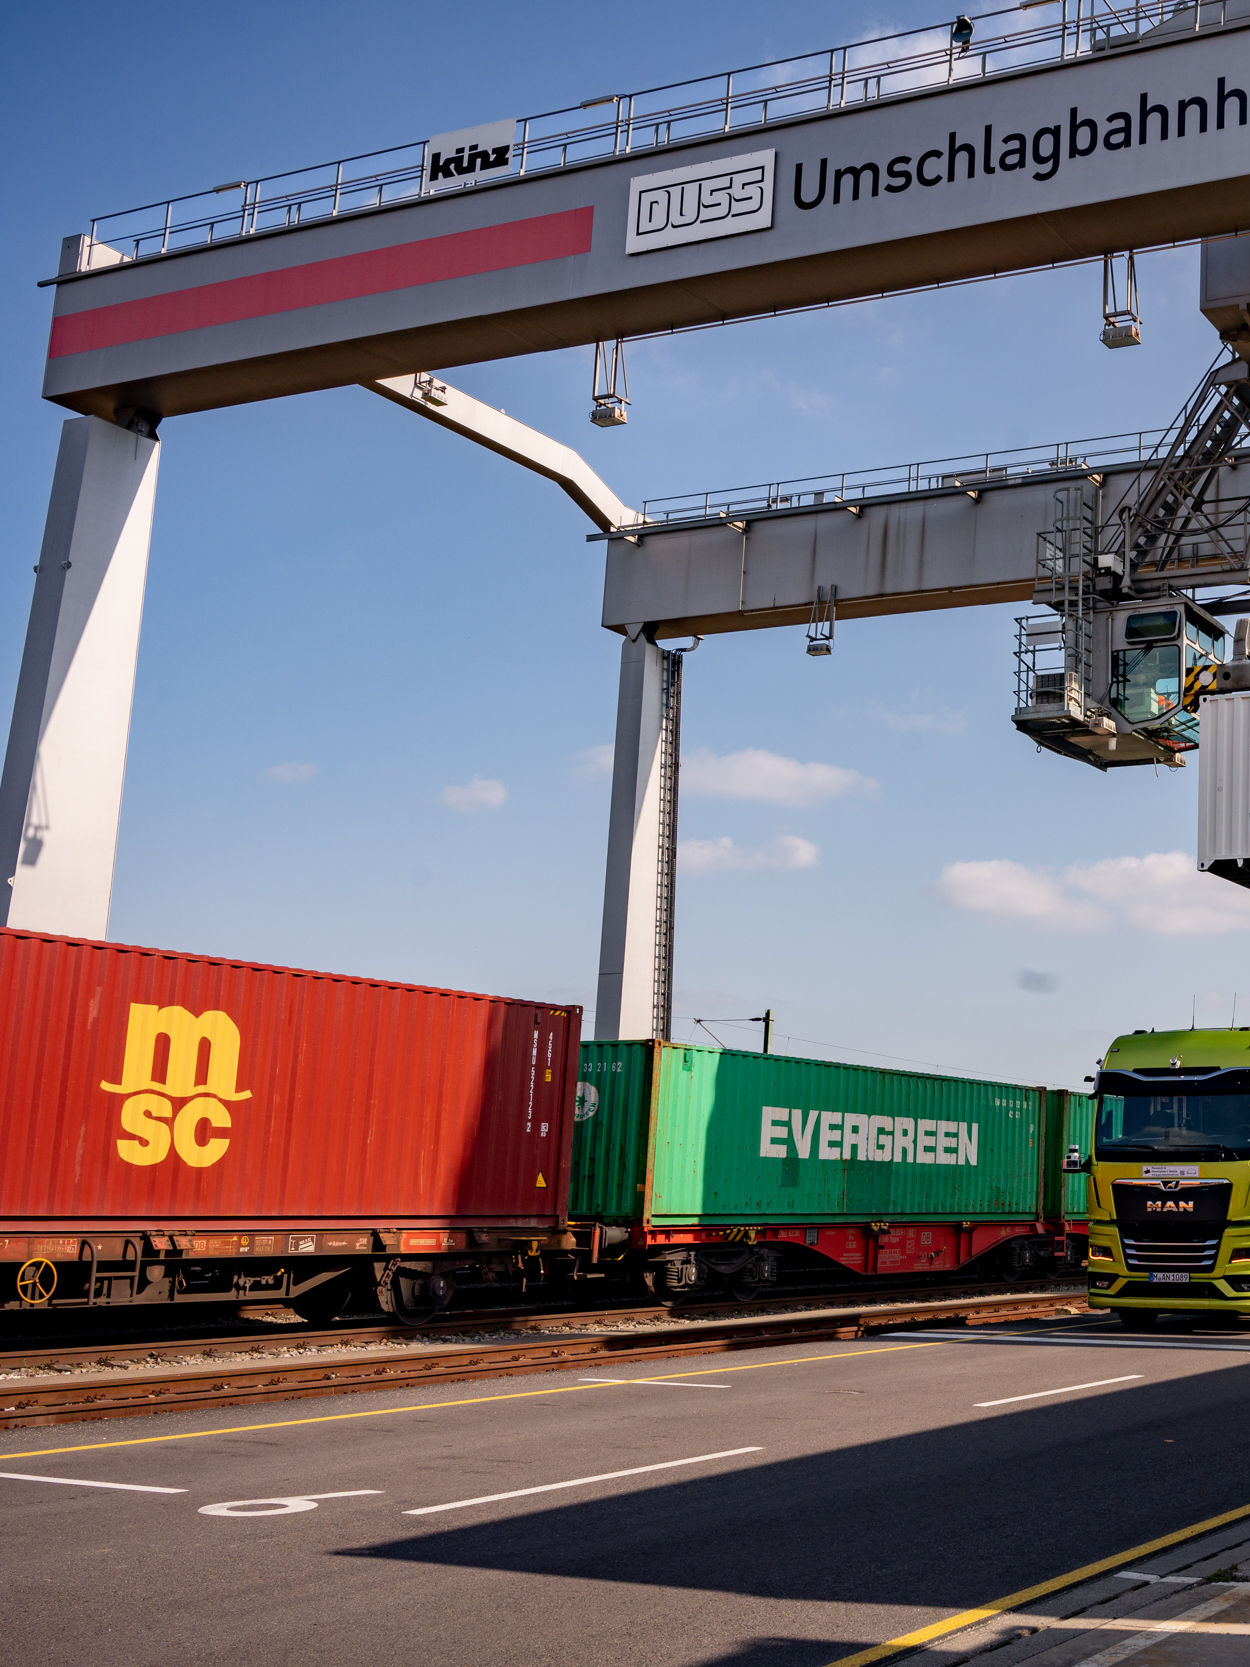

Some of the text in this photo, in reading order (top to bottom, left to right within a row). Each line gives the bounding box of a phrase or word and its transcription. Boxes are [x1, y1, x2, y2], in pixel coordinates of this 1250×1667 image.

[638, 167, 765, 234] DUSS
[527, 1066, 536, 1119] 522123
[760, 1106, 978, 1166] EVERGREEN
[1146, 1201, 1194, 1212] MAN
[922, 1233, 931, 1243] DB
[194, 1241, 205, 1250] DB
[1171, 1274, 1189, 1282] 1089
